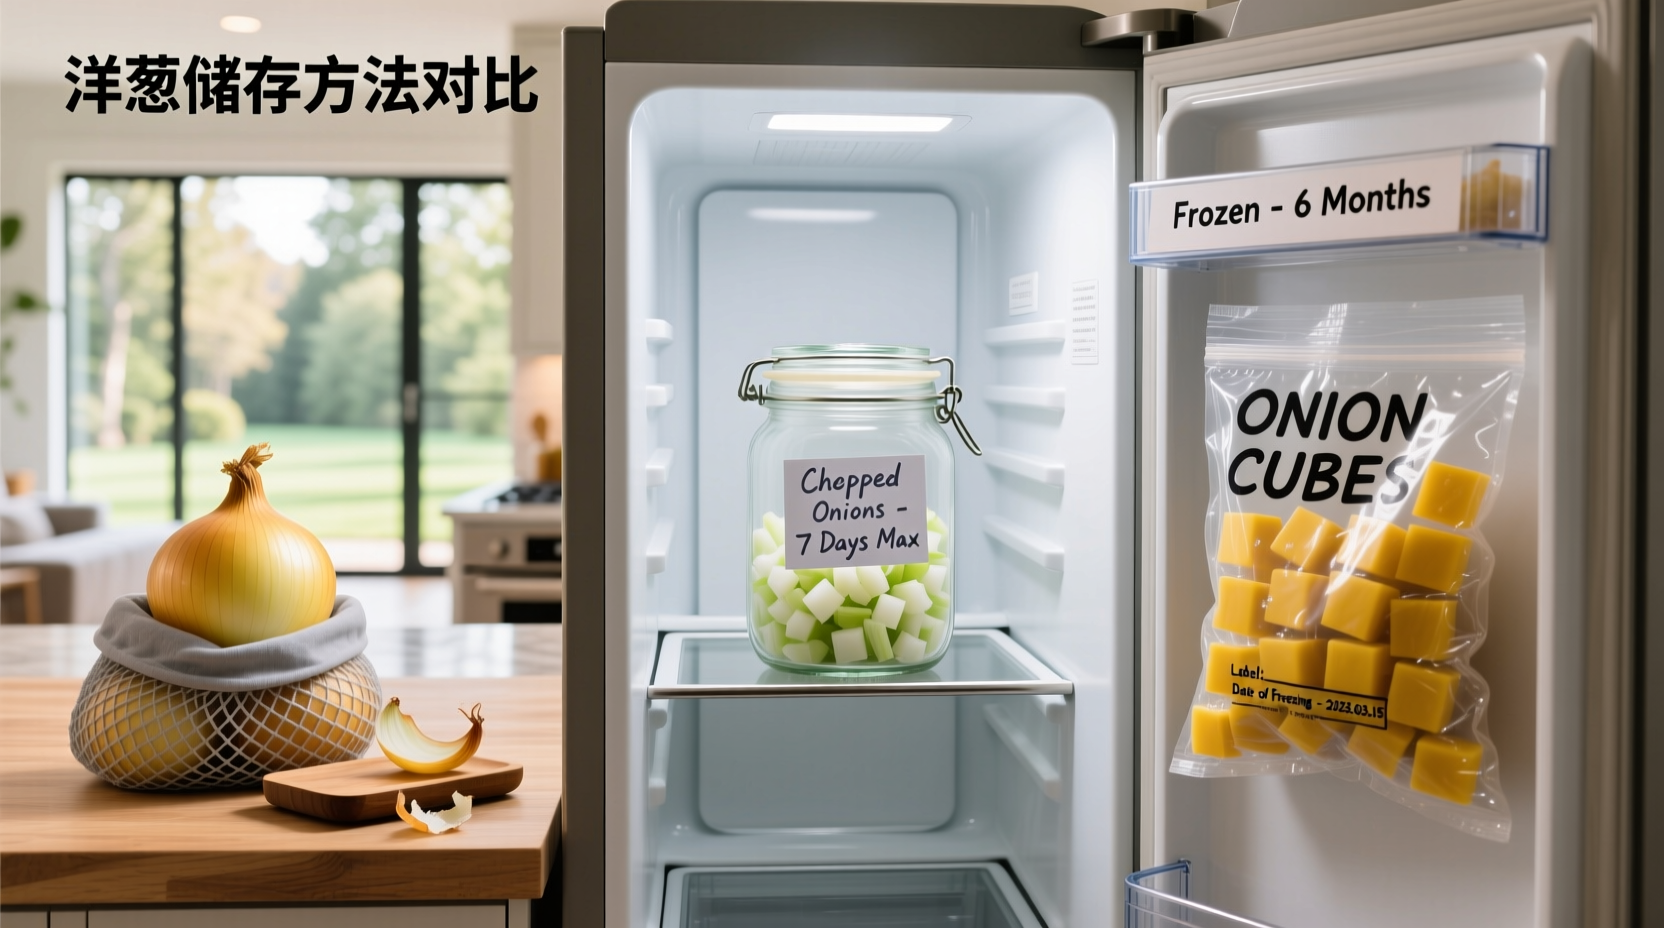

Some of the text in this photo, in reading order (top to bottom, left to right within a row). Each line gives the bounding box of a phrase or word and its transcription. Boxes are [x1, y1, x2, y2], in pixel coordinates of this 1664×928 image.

[1173, 178, 1431, 229] Frozen - 6 Months
[1237, 388, 1428, 442] ONION
[1228, 447, 1414, 505] CUBES
[812, 500, 885, 523] Onions
[795, 526, 920, 561] 7 Days Max
[1258, 687, 1269, 700] of
